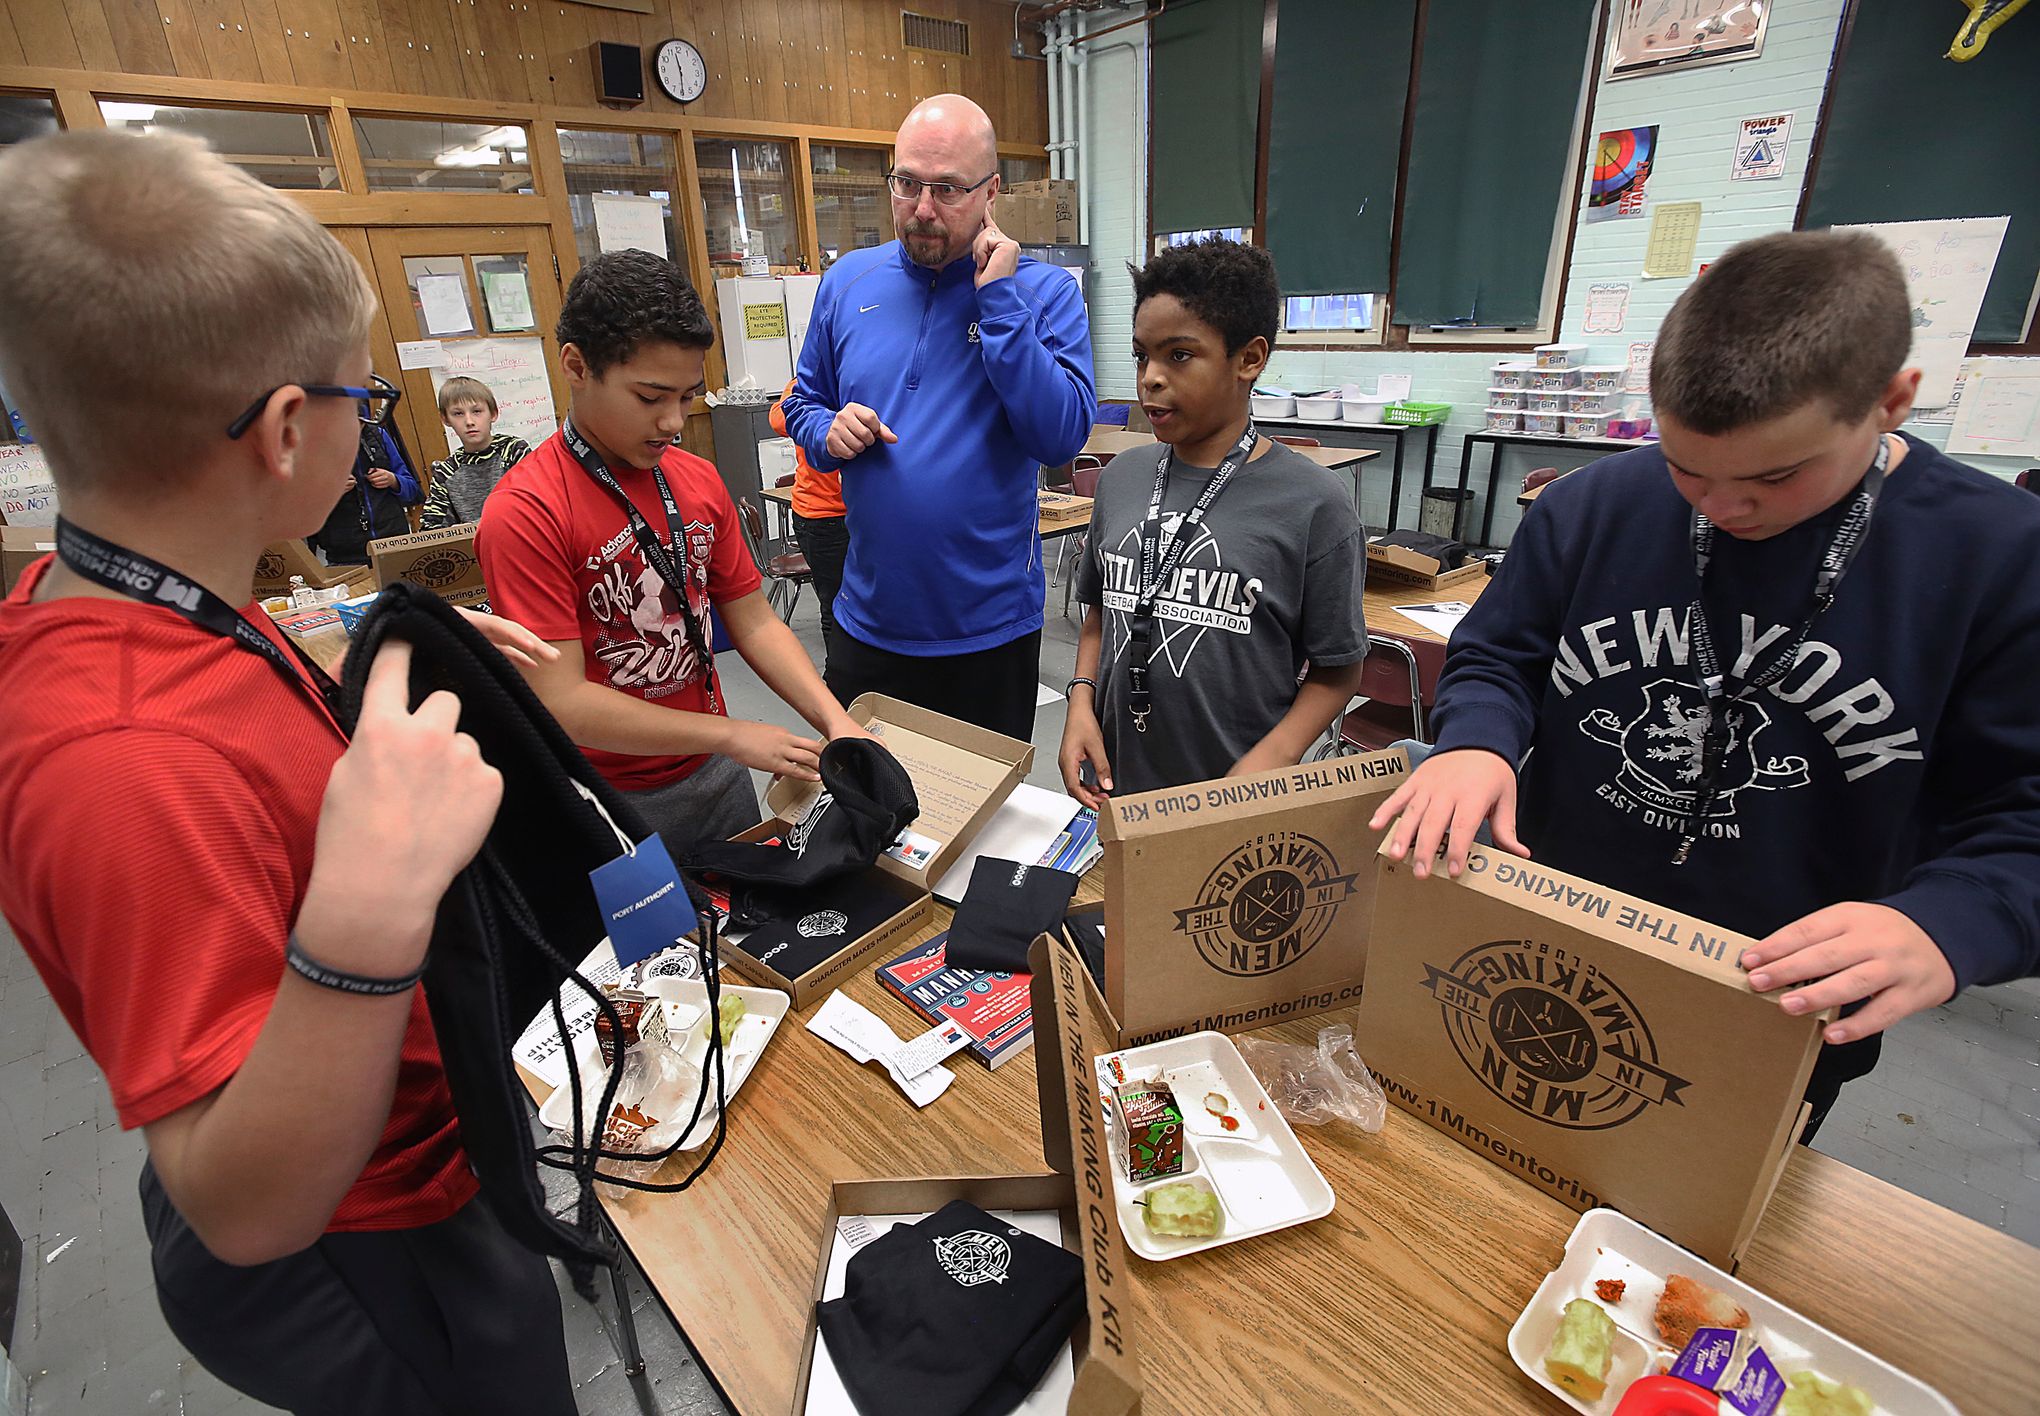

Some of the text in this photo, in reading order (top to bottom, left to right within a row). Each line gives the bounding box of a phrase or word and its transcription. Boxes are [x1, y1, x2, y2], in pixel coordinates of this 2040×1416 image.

[1744, 117, 1786, 131] POWER
[1630, 161, 1649, 209] TARGET
[1619, 190, 1632, 215] STAY
[440, 348, 475, 373] Divide
[1550, 352, 1566, 364] Bin
[1504, 377, 1518, 386] Bin
[1544, 378, 1561, 388] Bin
[1597, 379, 1615, 388] Bin
[1502, 398, 1516, 407] Bin
[1542, 400, 1557, 410] Bin
[1584, 401, 1600, 410] Bin
[1499, 419, 1514, 427] Bin
[1540, 420, 1556, 430] Bin
[1578, 423, 1596, 432] Bin
[1151, 458, 1168, 504] ONEMILLION
[1197, 461, 1233, 508] ONEMILLION
[1203, 500, 1212, 509] MEN
[1212, 483, 1222, 496] THE
[1218, 464, 1236, 486] MAKING
[6, 497, 49, 514] DO NOT
[388, 538, 408, 546] Club
[410, 533, 444, 544] MAKING
[446, 528, 462, 536] THE
[1822, 492, 1870, 568] ONEMILLION
[375, 542, 388, 550] Kit
[1170, 540, 1186, 566] MAKING
[1367, 547, 1385, 556] MEN
[113, 553, 129, 565] IN
[129, 562, 162, 579] MEN
[1142, 537, 1151, 592] ONEMILLION
[1154, 538, 1182, 588] ONEMILLION
[426, 574, 456, 587] MEN
[1160, 566, 1264, 616] DEVILS
[1152, 604, 1249, 630] ASSOCIATION
[1691, 600, 1712, 676] ONEMILLION
[1550, 606, 1926, 783] NEW YORK
[1120, 756, 1404, 823] MEN IN THE MAKING Club Kit
[1595, 783, 1741, 839] EAST DIVIION
[1244, 831, 1297, 849] CLUBS
[1215, 842, 1325, 893] MAKING
[612, 881, 676, 920] PORT AUTHORITY
[1317, 886, 1334, 903] IN
[1193, 911, 1224, 929] THE
[1495, 862, 1727, 961] IN THE MAKING
[808, 906, 927, 989] CHARACTER MAKES HIM INVALUABLE
[1229, 925, 1304, 972] MEN
[1522, 938, 1601, 977] CLUBS
[912, 956, 945, 978] MANU
[320, 974, 338, 986] IN
[340, 978, 371, 992] THE
[912, 967, 985, 1006] MANH
[1444, 984, 1482, 1014] THE
[1476, 952, 1637, 1041] MAKING
[994, 1017, 1022, 1036] JONATHAN
[1129, 984, 1364, 1048] www.1Mmentoring.co
[1480, 1041, 1589, 1122] MEN
[1615, 1062, 1644, 1089] IN
[1056, 948, 1124, 1359] MEN IN THE MAKING Club Kit
[968, 1232, 1006, 1258] MEN
[986, 1265, 1000, 1277] THE
